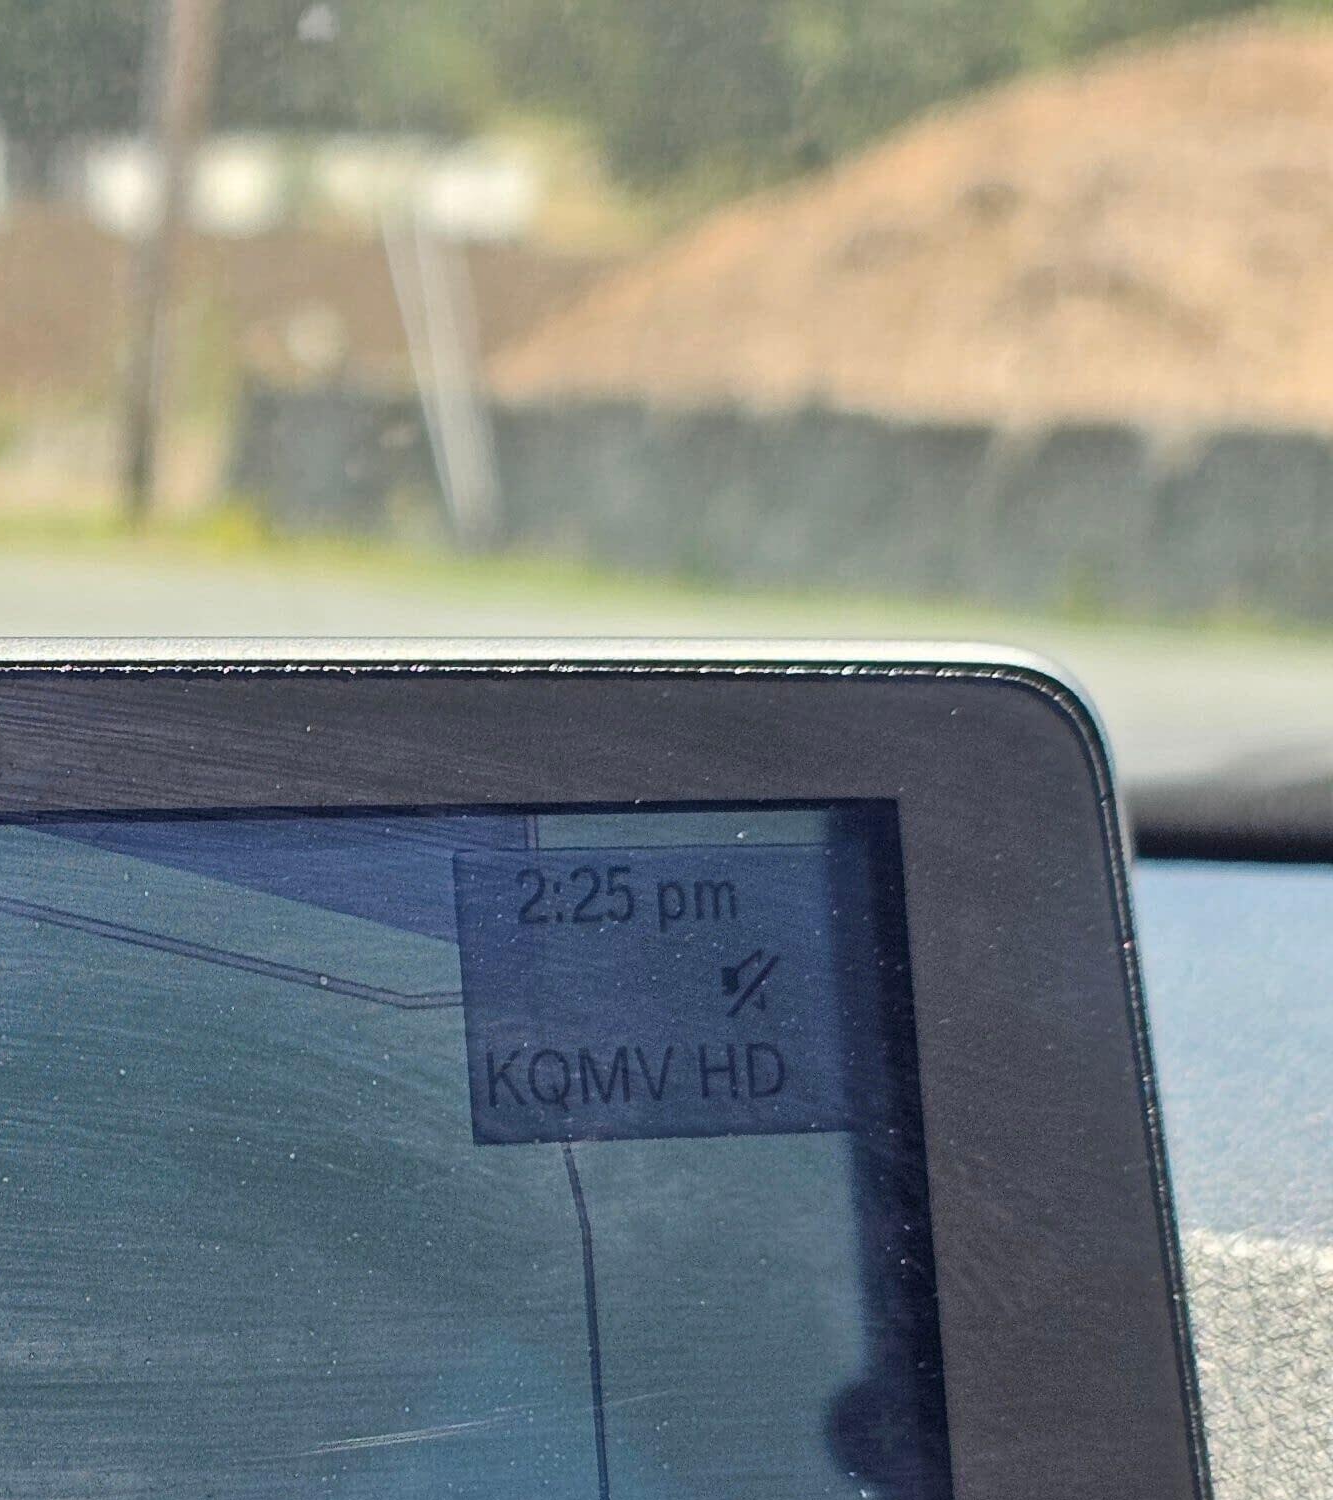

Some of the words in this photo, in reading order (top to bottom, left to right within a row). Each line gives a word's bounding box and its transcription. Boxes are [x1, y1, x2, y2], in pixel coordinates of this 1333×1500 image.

[517, 866, 633, 925] 2:25
[657, 876, 735, 931] pm
[485, 1046, 673, 1110] KQMV
[699, 1042, 785, 1100] HD
